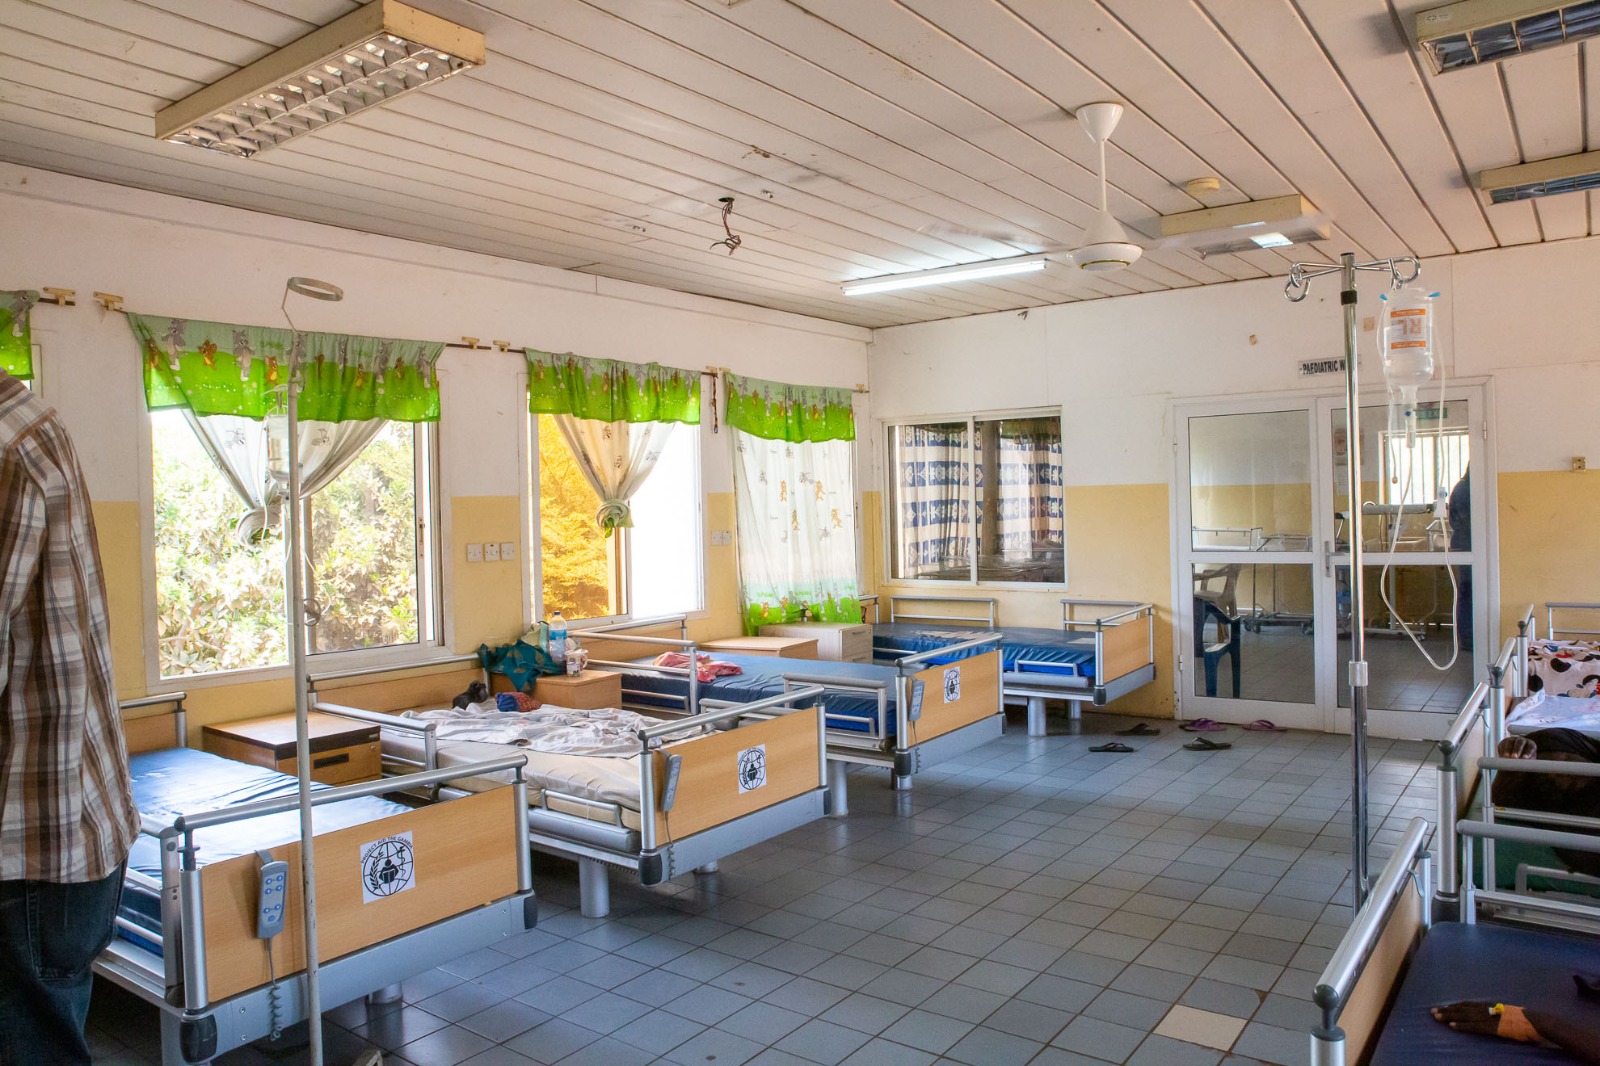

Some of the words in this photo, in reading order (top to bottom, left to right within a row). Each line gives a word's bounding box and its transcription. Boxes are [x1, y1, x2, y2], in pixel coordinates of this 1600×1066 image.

[1397, 319, 1422, 336] RL
[1302, 360, 1339, 375] PAEDIATRIC
[361, 842, 377, 864] PROJECT
